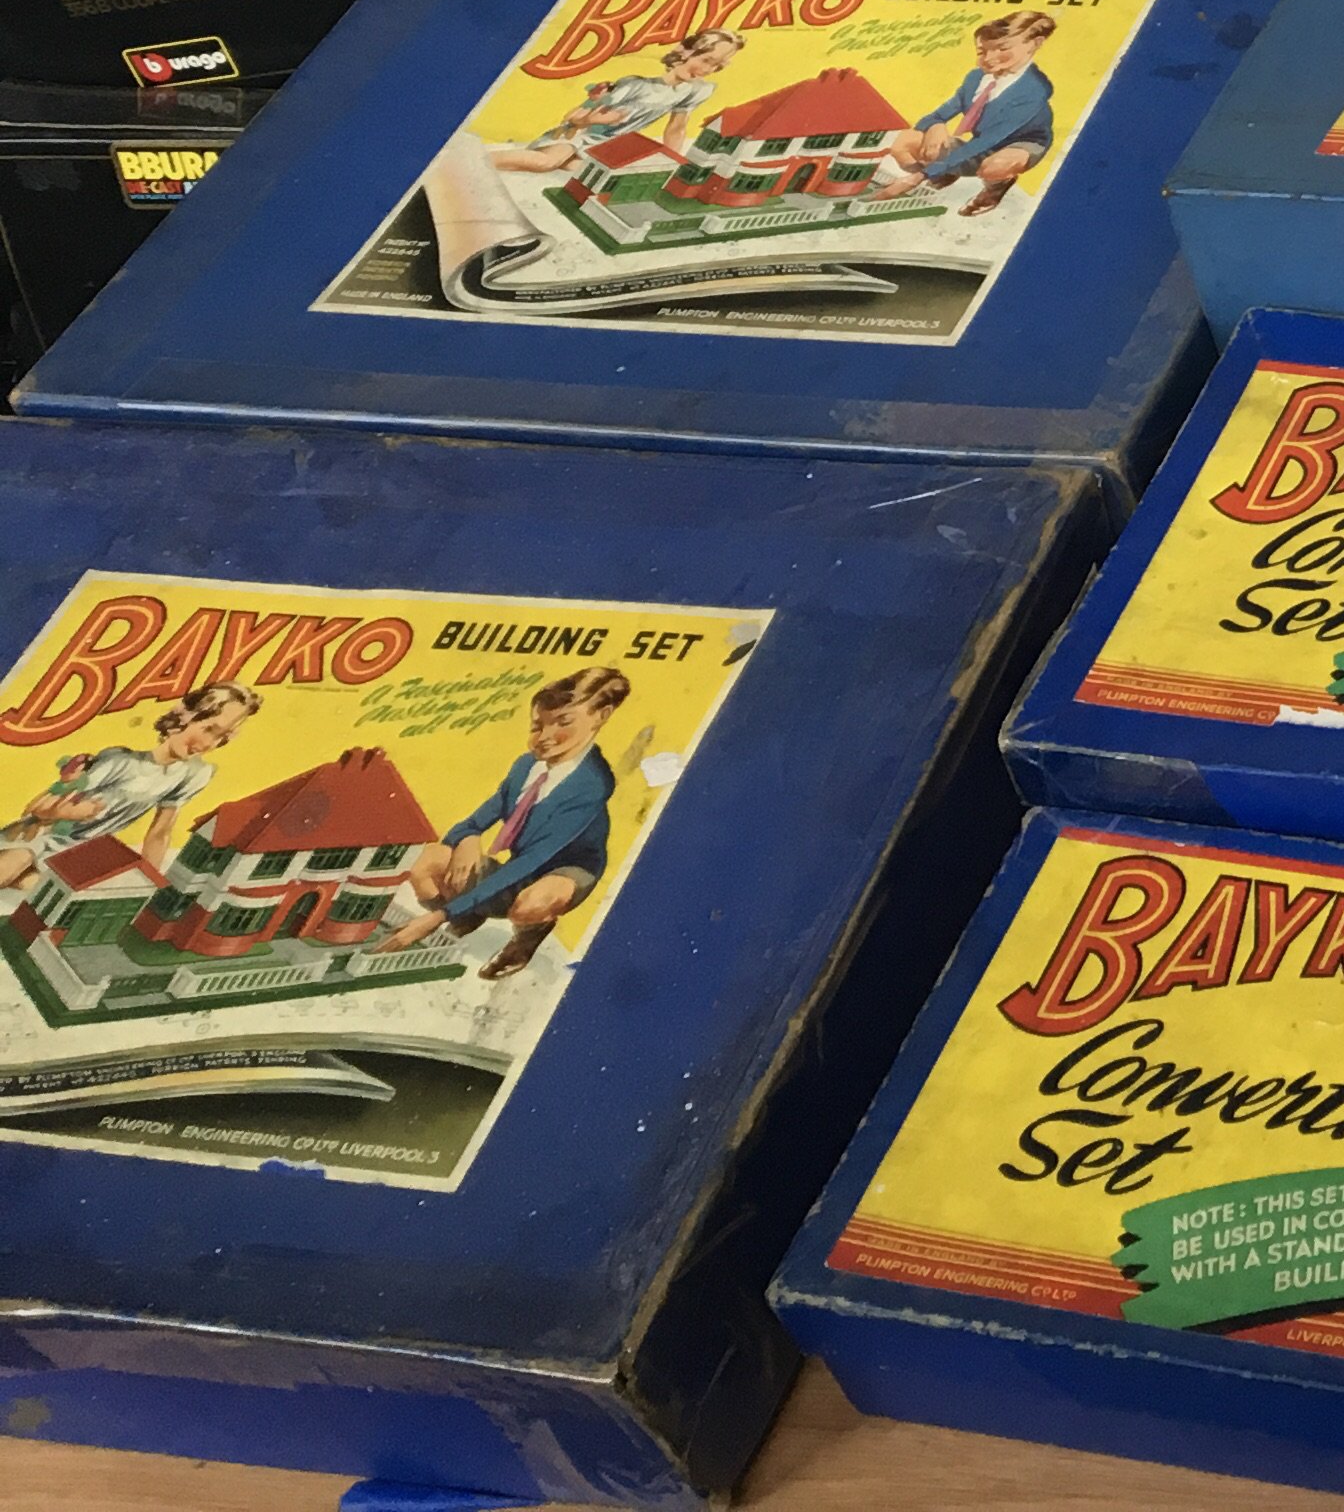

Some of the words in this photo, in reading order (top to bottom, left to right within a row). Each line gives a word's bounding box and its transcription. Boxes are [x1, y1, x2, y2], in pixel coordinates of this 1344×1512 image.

[136, 50, 227, 80] burago
[0, 596, 414, 746] BAYKO
[432, 620, 609, 657] BUILDING
[625, 630, 704, 662] SET
[98, 1116, 175, 1136] PLIMPTON
[180, 1125, 291, 1148] ENGINEERING
[999, 1110, 1192, 1193] Set
[1213, 1222, 1274, 1250] USED
[1171, 1256, 1236, 1283] WITH
